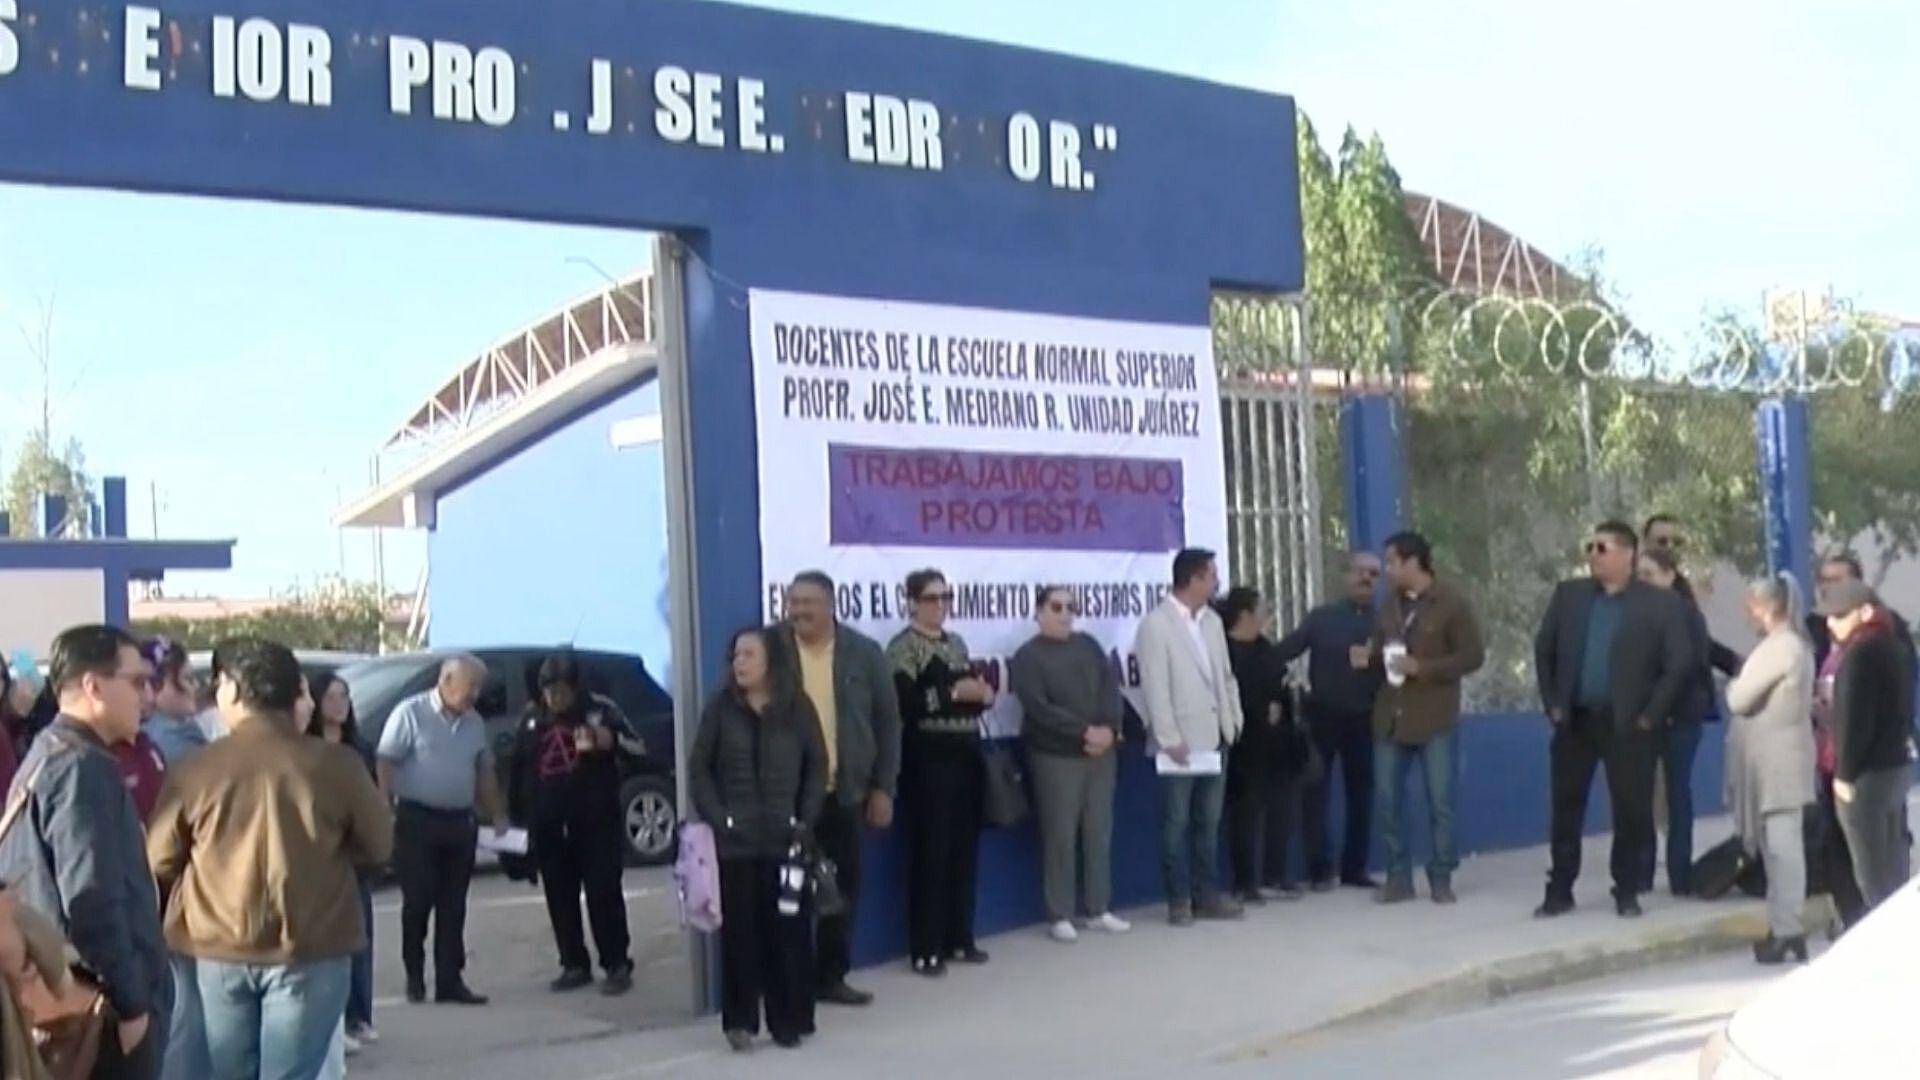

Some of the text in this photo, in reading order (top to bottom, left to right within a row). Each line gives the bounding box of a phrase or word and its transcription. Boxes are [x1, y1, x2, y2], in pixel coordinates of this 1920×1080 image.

[774, 322, 1198, 392] DOCENTES DE LA ESCUELA NORMAL SUPERIOR
[783, 374, 1200, 438] PROFR. JOSÉ E. MEDRANO R. UNIDAD JUÁREZ
[846, 453, 1175, 495] TRABAJAMOS BAJO
[919, 498, 1106, 536] PROTESTA
[870, 581, 893, 620] EL
[1066, 583, 1143, 620] UESTROS
